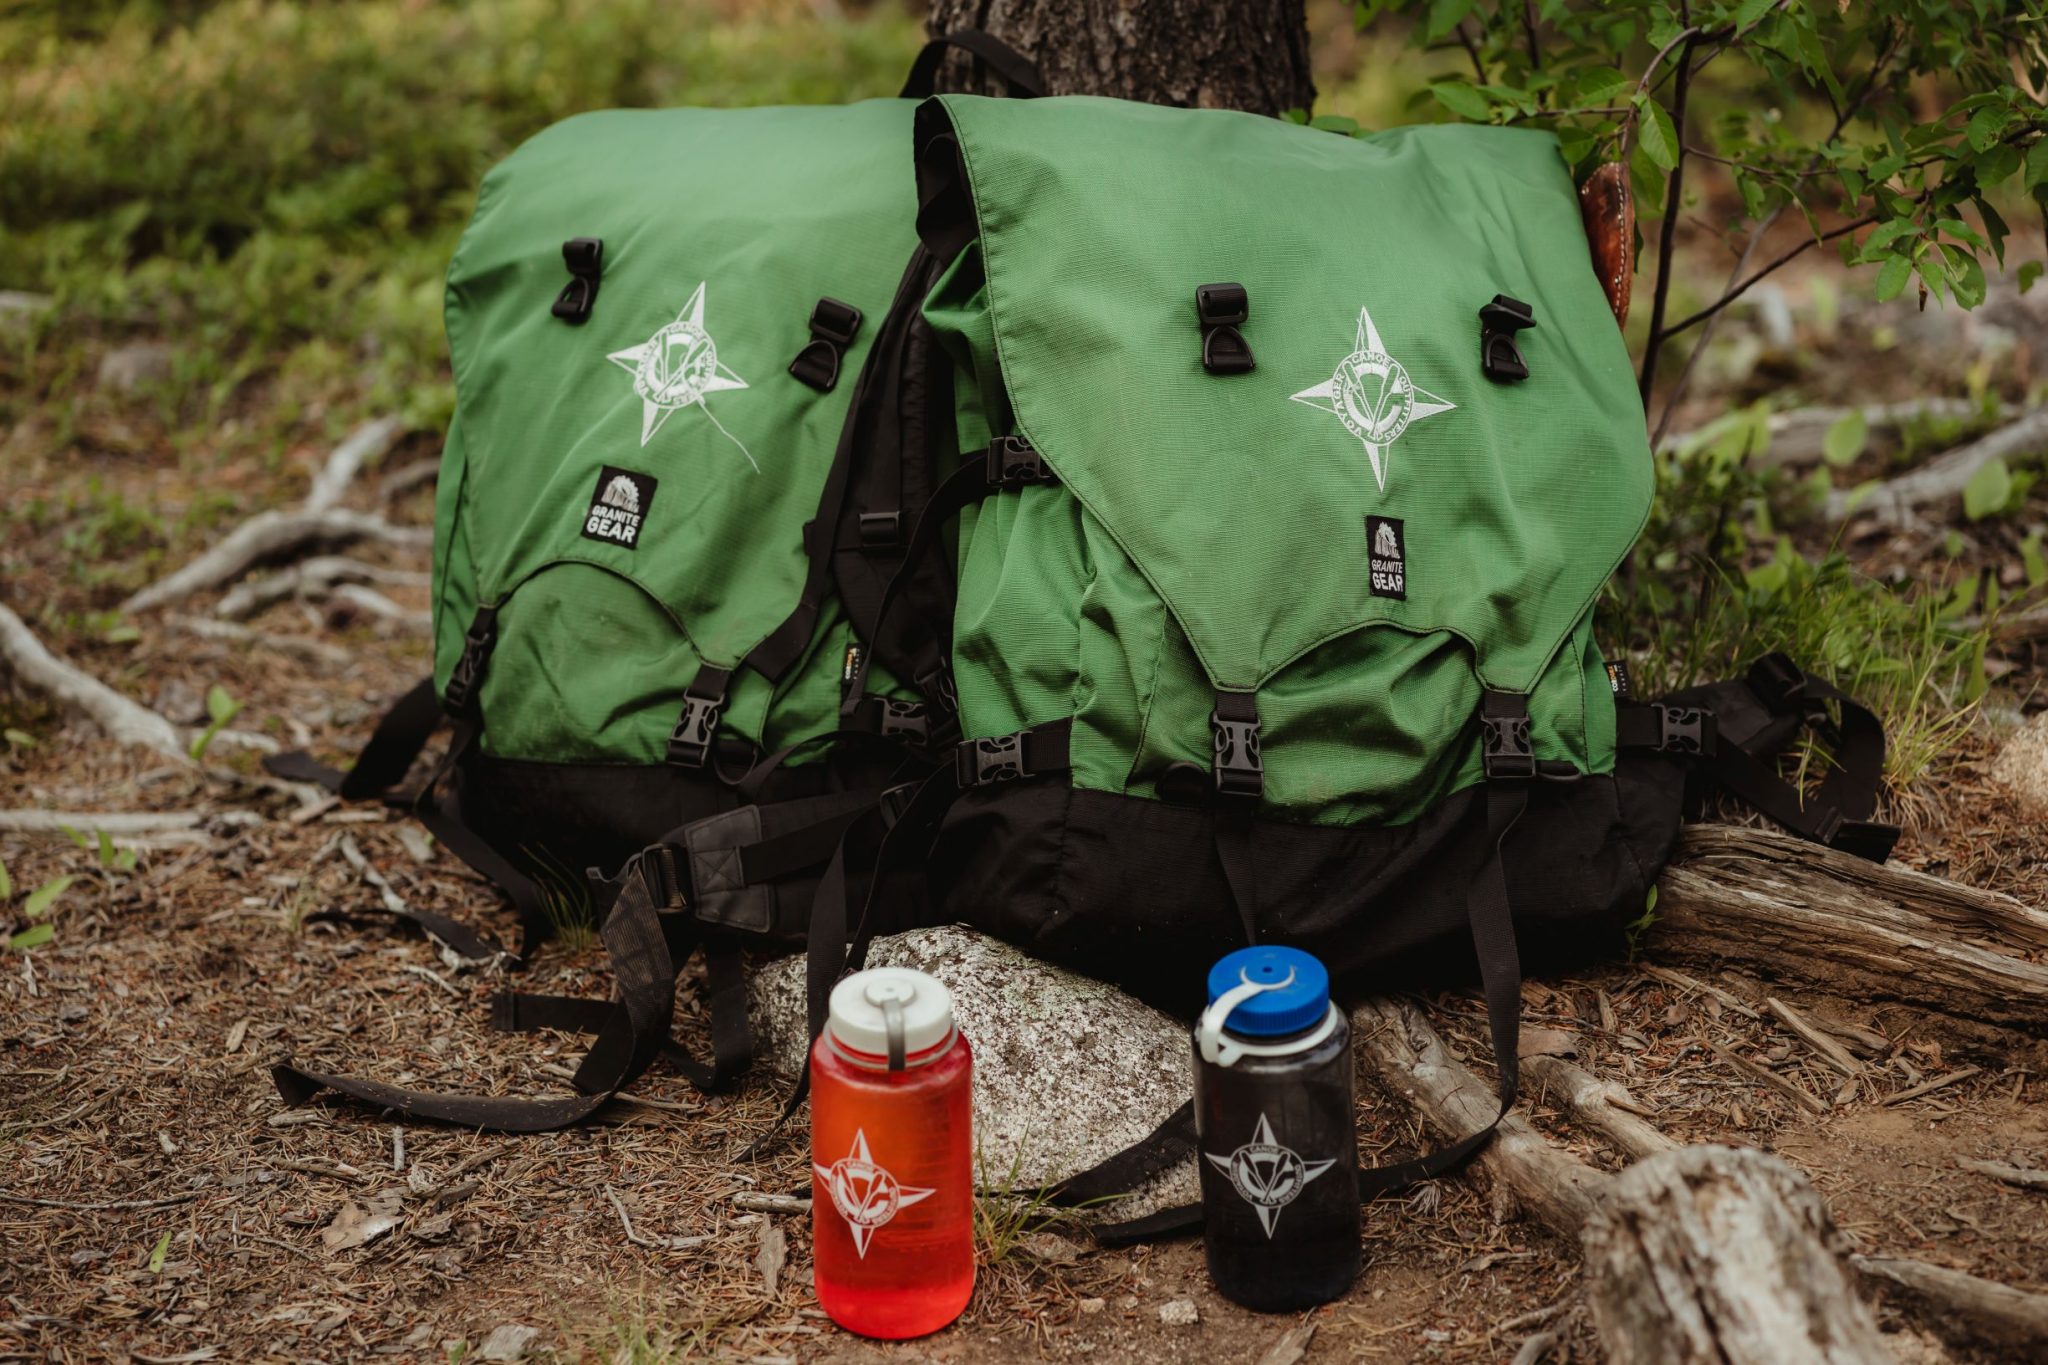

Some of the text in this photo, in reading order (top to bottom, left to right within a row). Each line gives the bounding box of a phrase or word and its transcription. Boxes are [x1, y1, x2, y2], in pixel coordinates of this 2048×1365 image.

[1333, 352, 1412, 441] VOYAGER CANOE OUTFITTERS
[591, 505, 641, 527] GRANITE
[586, 516, 636, 543] GEAR
[1371, 559, 1404, 574] GRANITE
[1372, 572, 1404, 593] GEAR
